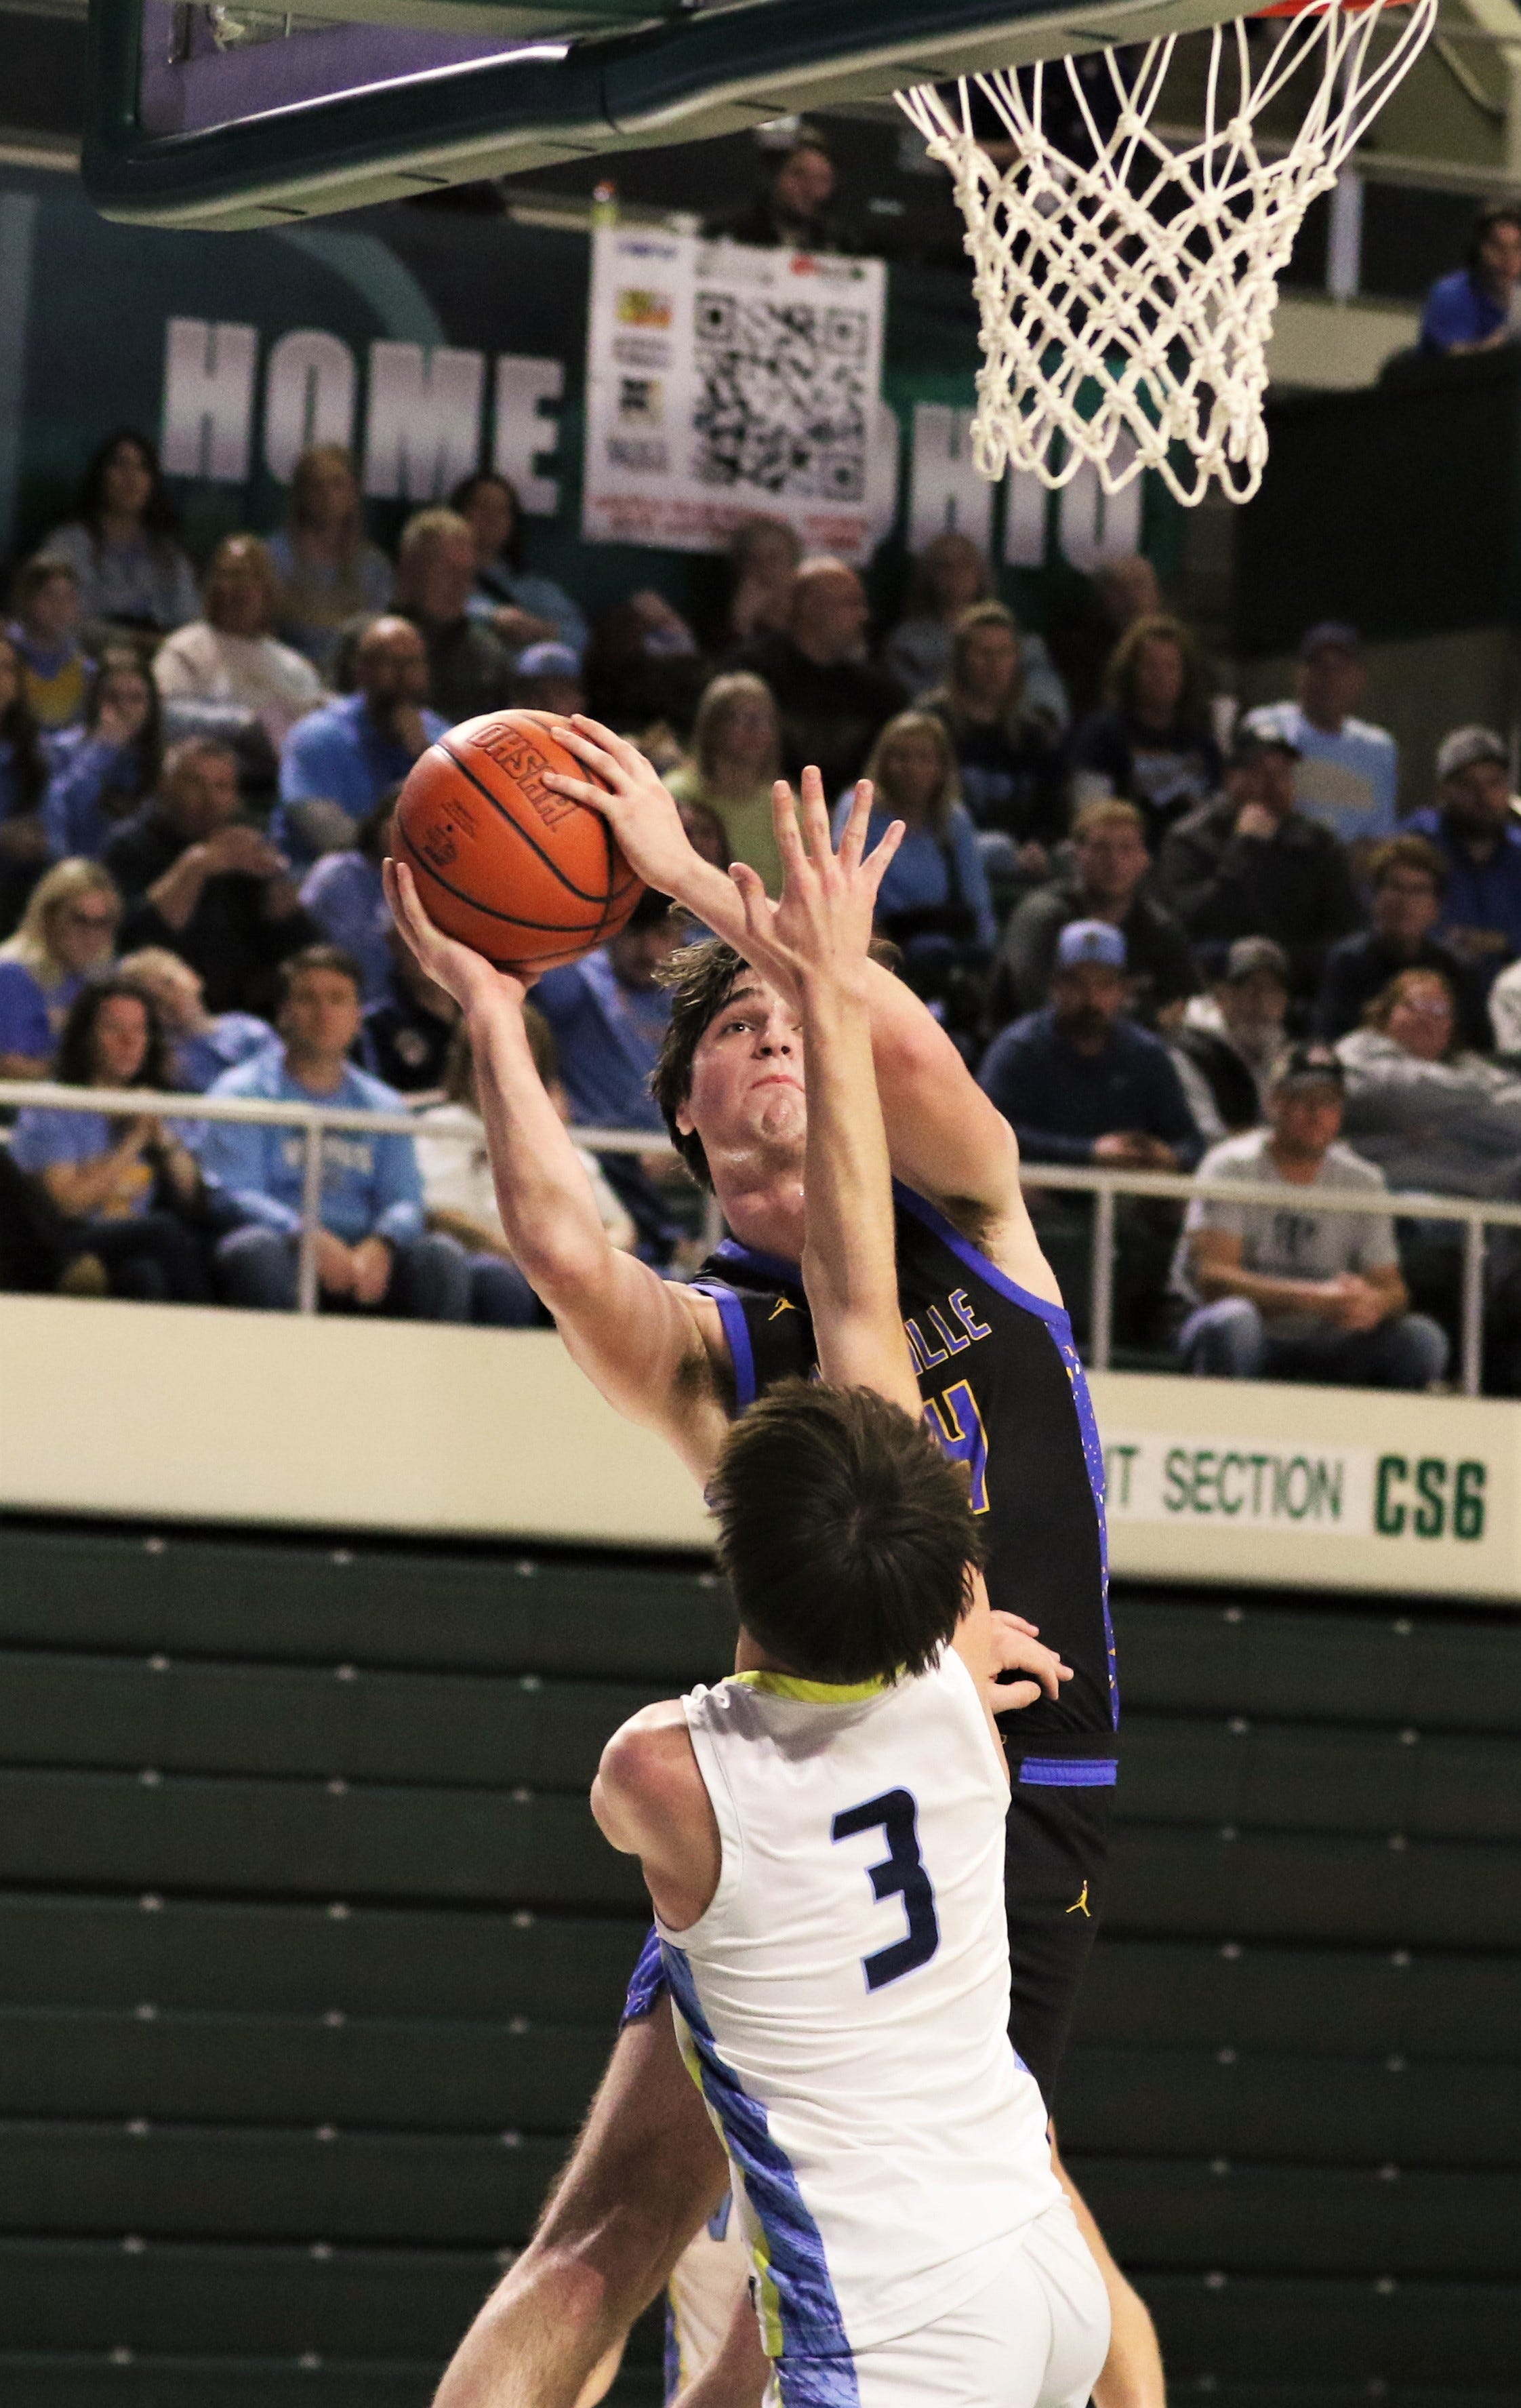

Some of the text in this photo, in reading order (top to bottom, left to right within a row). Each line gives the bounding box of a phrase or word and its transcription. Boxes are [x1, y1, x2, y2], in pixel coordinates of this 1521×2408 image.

[161, 315, 564, 515] HOME
[1103, 1445, 1486, 1540] T SECTION CS6
[830, 1785, 941, 1994] 3
